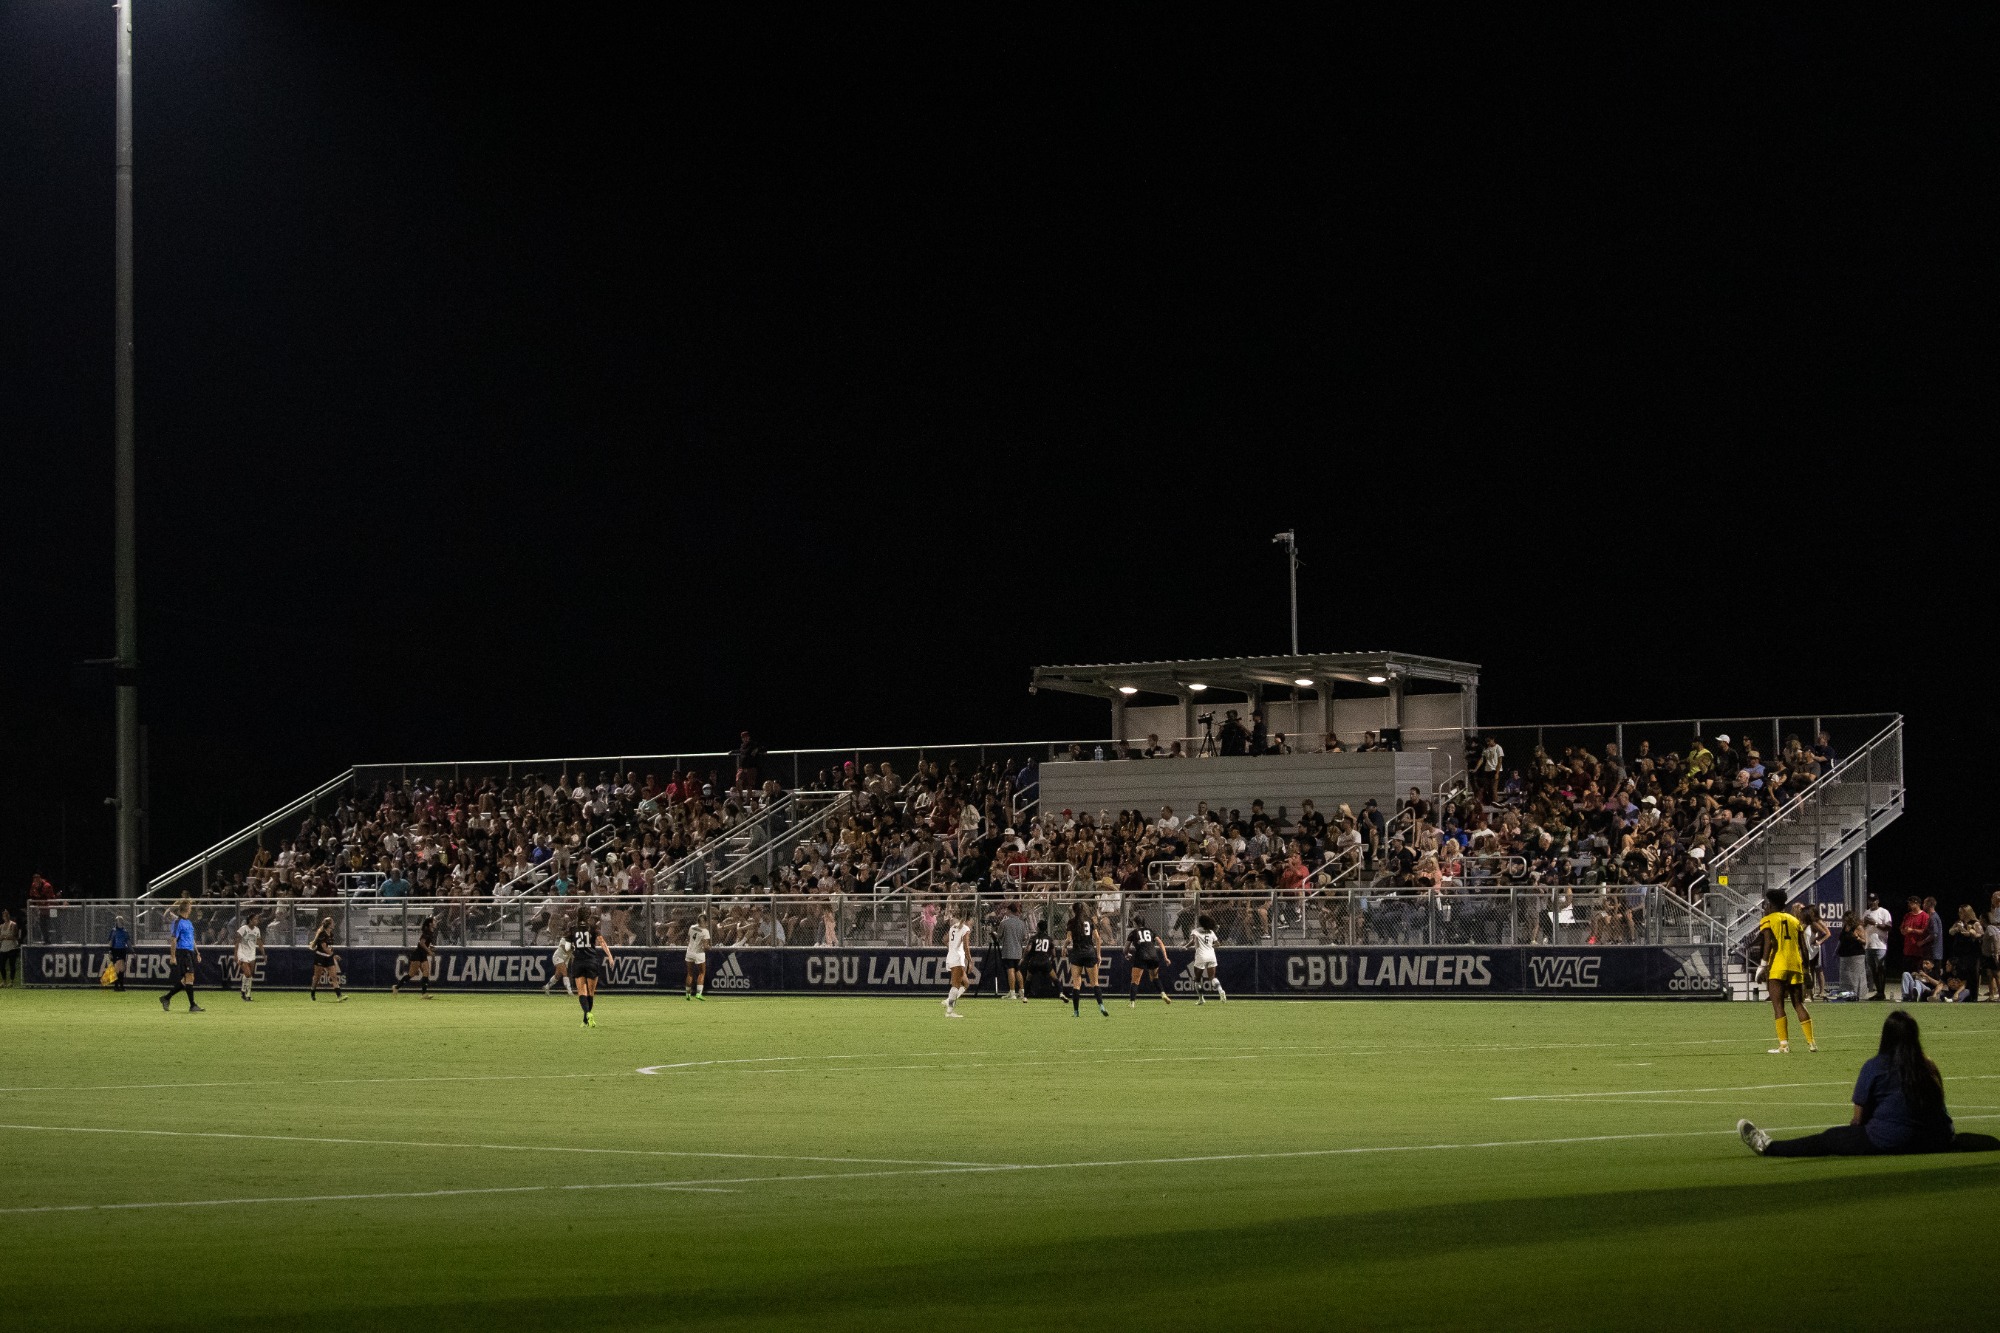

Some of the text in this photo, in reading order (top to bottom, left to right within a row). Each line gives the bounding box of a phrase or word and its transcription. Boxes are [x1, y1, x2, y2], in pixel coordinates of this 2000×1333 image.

[1819, 903, 1844, 919] CBU
[951, 930, 956, 942] 5
[1137, 930, 1152, 943] 16
[1782, 920, 1791, 940] 1
[575, 931, 592, 948] 21
[1035, 938, 1049, 953] 20
[42, 953, 172, 979] CBU LACERS
[447, 955, 548, 982] LANCERS
[602, 956, 658, 985] WAC
[807, 956, 983, 985] CBU LANCES
[1287, 955, 1492, 986] CBU LANCERS
[1529, 956, 1602, 987] WAC
[711, 976, 751, 989] adidas
[1668, 976, 1719, 991] adidas
